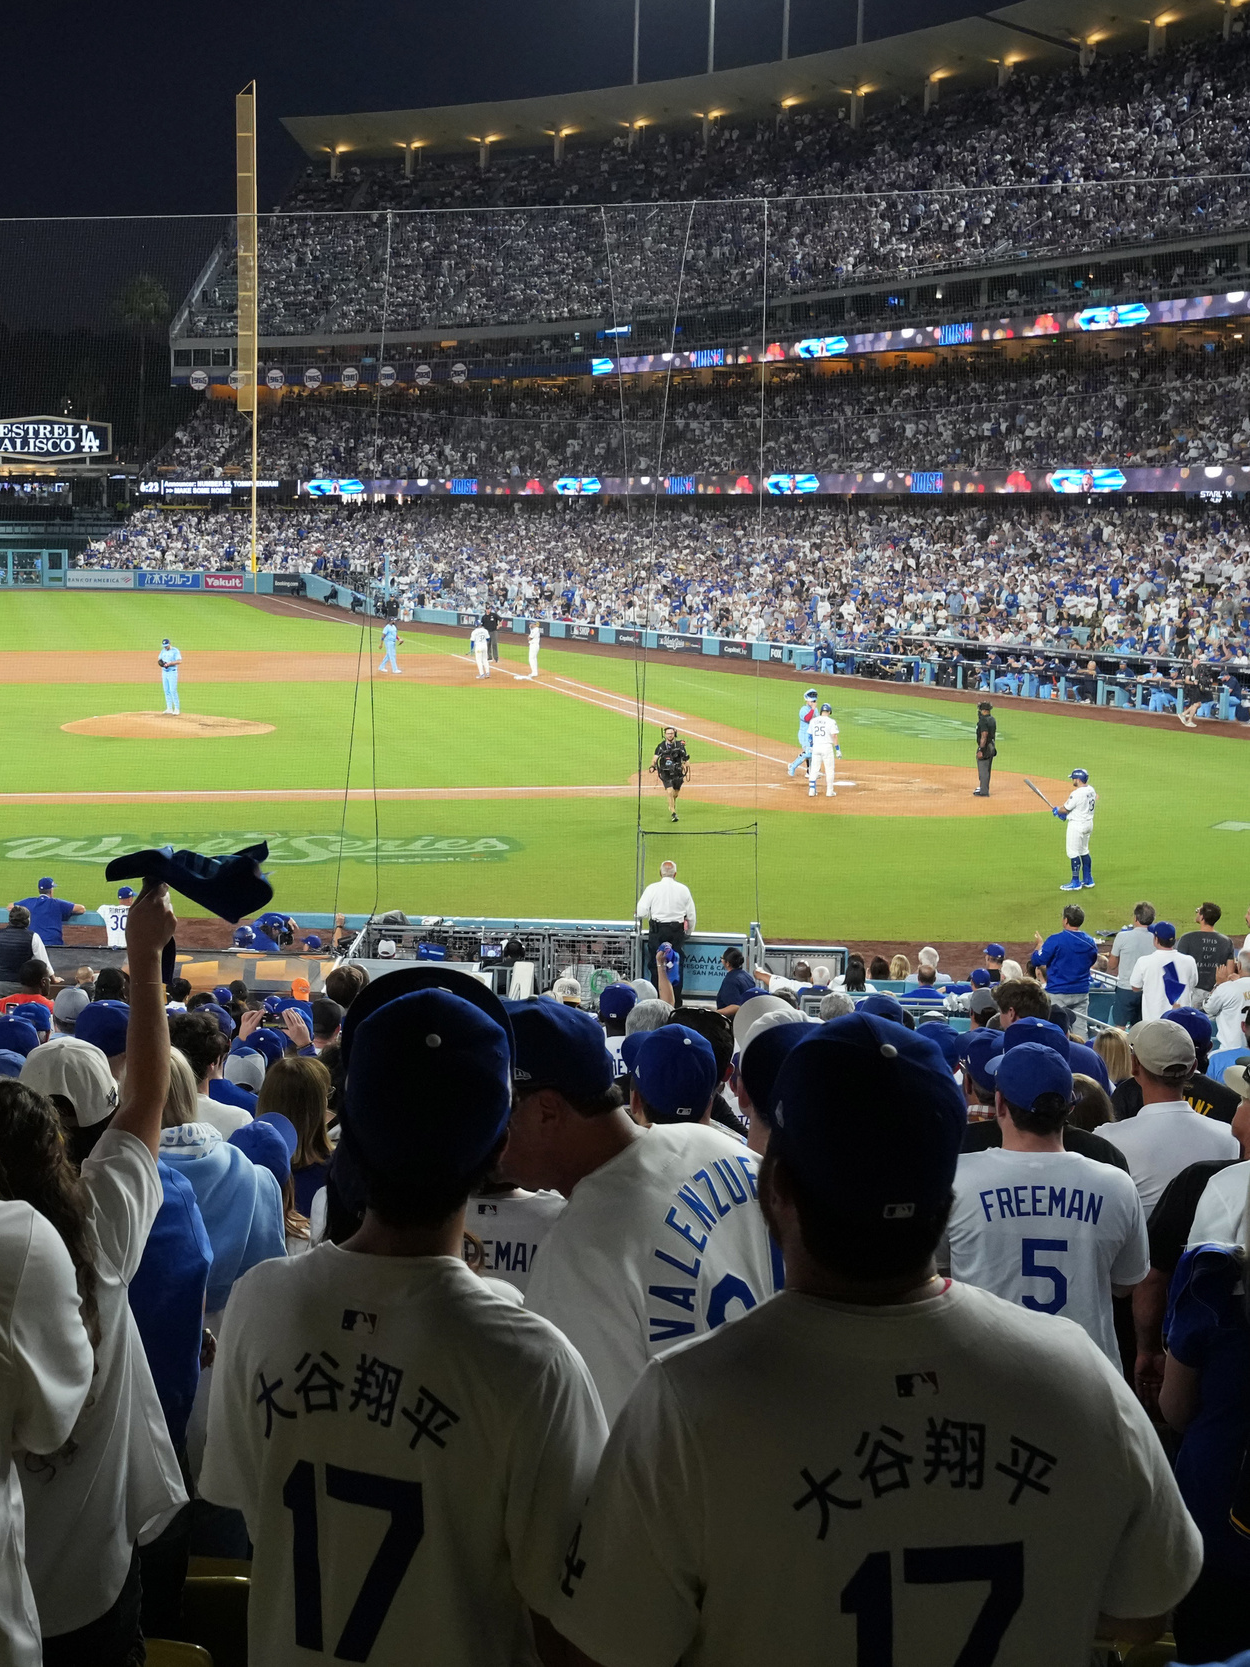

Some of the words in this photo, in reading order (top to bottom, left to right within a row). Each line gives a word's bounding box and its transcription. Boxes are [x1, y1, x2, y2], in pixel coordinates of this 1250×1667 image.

[268, 376, 283, 384] 1963
[306, 375, 321, 383] 1965
[343, 373, 358, 381] 1981
[415, 371, 431, 379] 2020
[80, 425, 100, 453] LA
[140, 481, 160, 493] 6:23
[450, 479, 477, 495] NOISE!
[910, 472, 943, 494] NOISE!
[153, 574, 192, 585] 木下グループ
[206, 577, 242, 587] Yakult
[771, 648, 782, 658] FOX
[814, 726, 826, 737] 25
[1088, 799, 1095, 812] 13
[110, 914, 128, 930] 30
[979, 1185, 1103, 1225] FREEMAN
[648, 1154, 760, 1342] VALENZUE
[1021, 1238, 1068, 1315] 5
[257, 1350, 460, 1450] 大谷翔平
[792, 1416, 1058, 1541] 大谷翔平
[283, 1459, 425, 1663] 17
[840, 1541, 1024, 1667] 17
